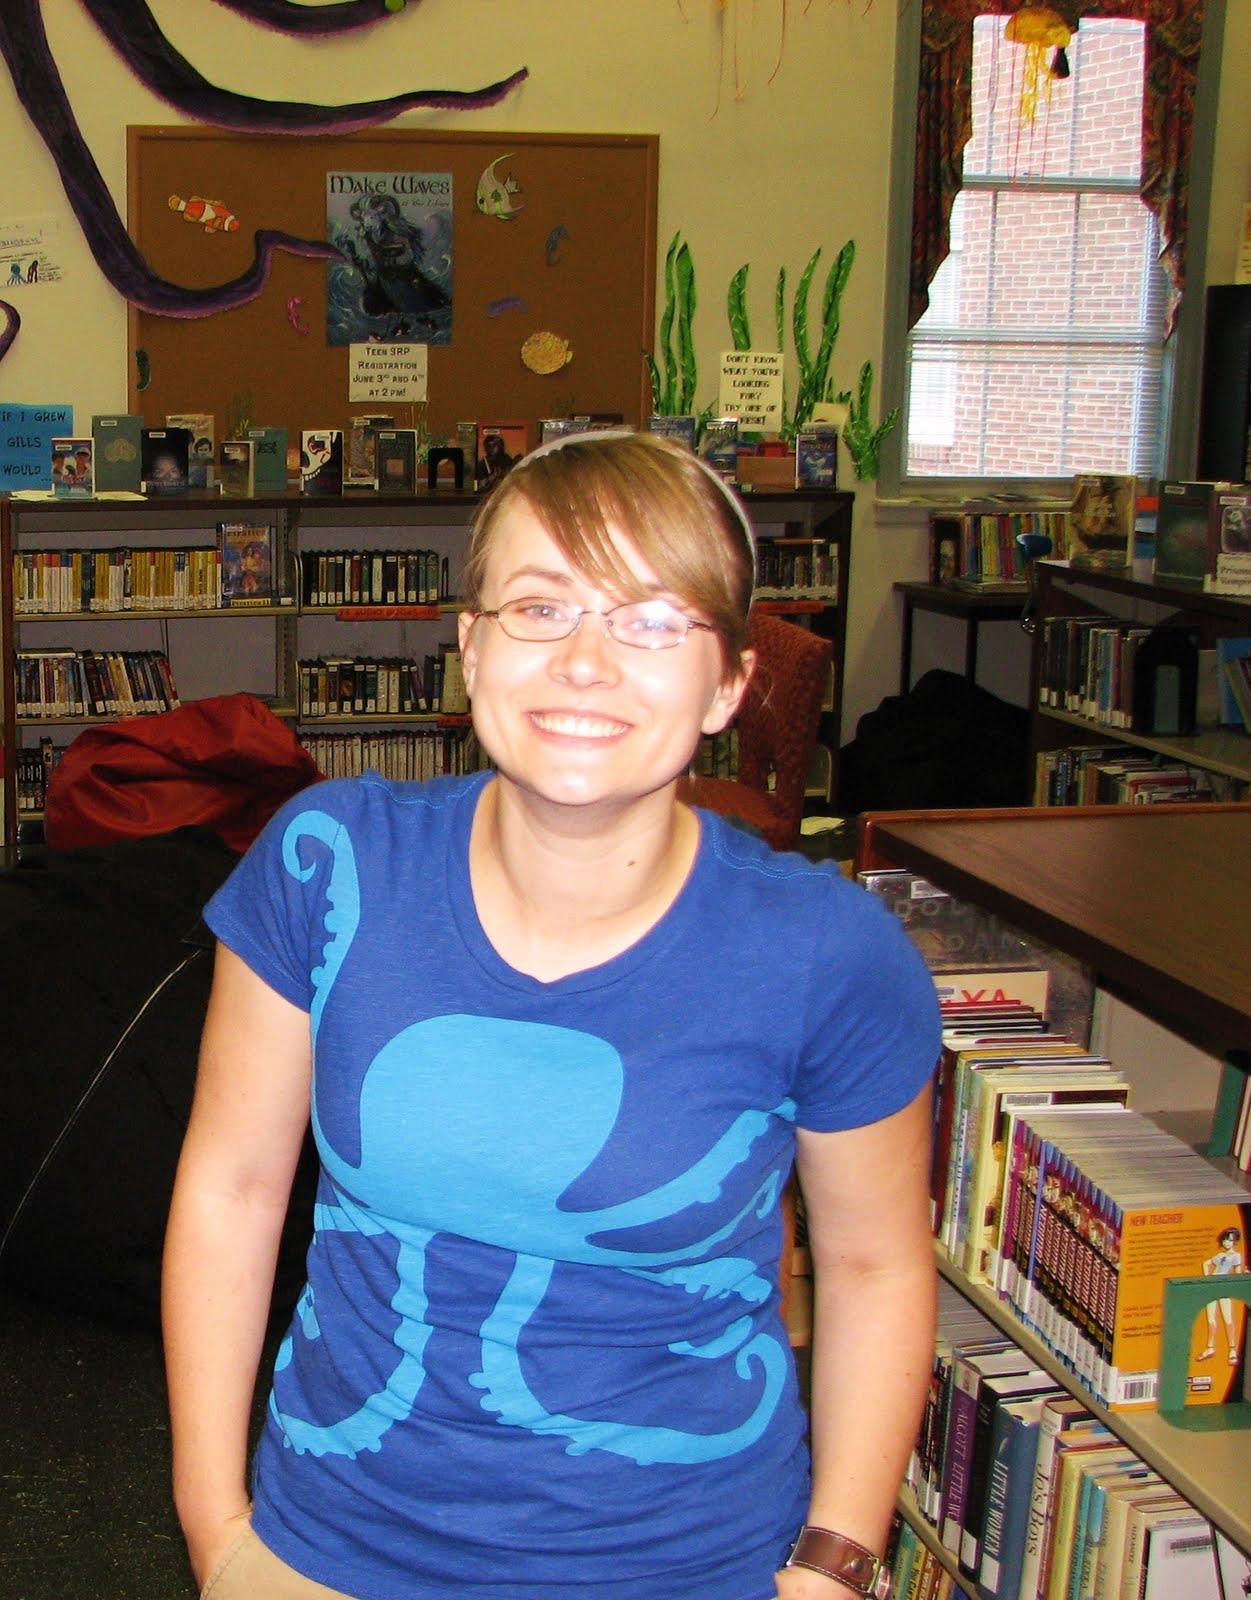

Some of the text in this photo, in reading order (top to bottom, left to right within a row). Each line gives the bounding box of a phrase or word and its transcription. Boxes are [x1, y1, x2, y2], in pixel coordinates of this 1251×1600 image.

[330, 175, 450, 194] Make Waves
[390, 347, 410, 355] SRP
[358, 361, 417, 369] REGISTRATION
[353, 374, 374, 383] JUNE
[381, 388, 388, 396] 2
[34, 411, 66, 422] GREW
[7, 437, 42, 448] GILLS
[1130, 1214, 1147, 1226] NEW
[954, 1408, 969, 1461] ALCOTT
[948, 1463, 965, 1507] LITTLE
[984, 1460, 1009, 1556] LITTLE WOMEN
